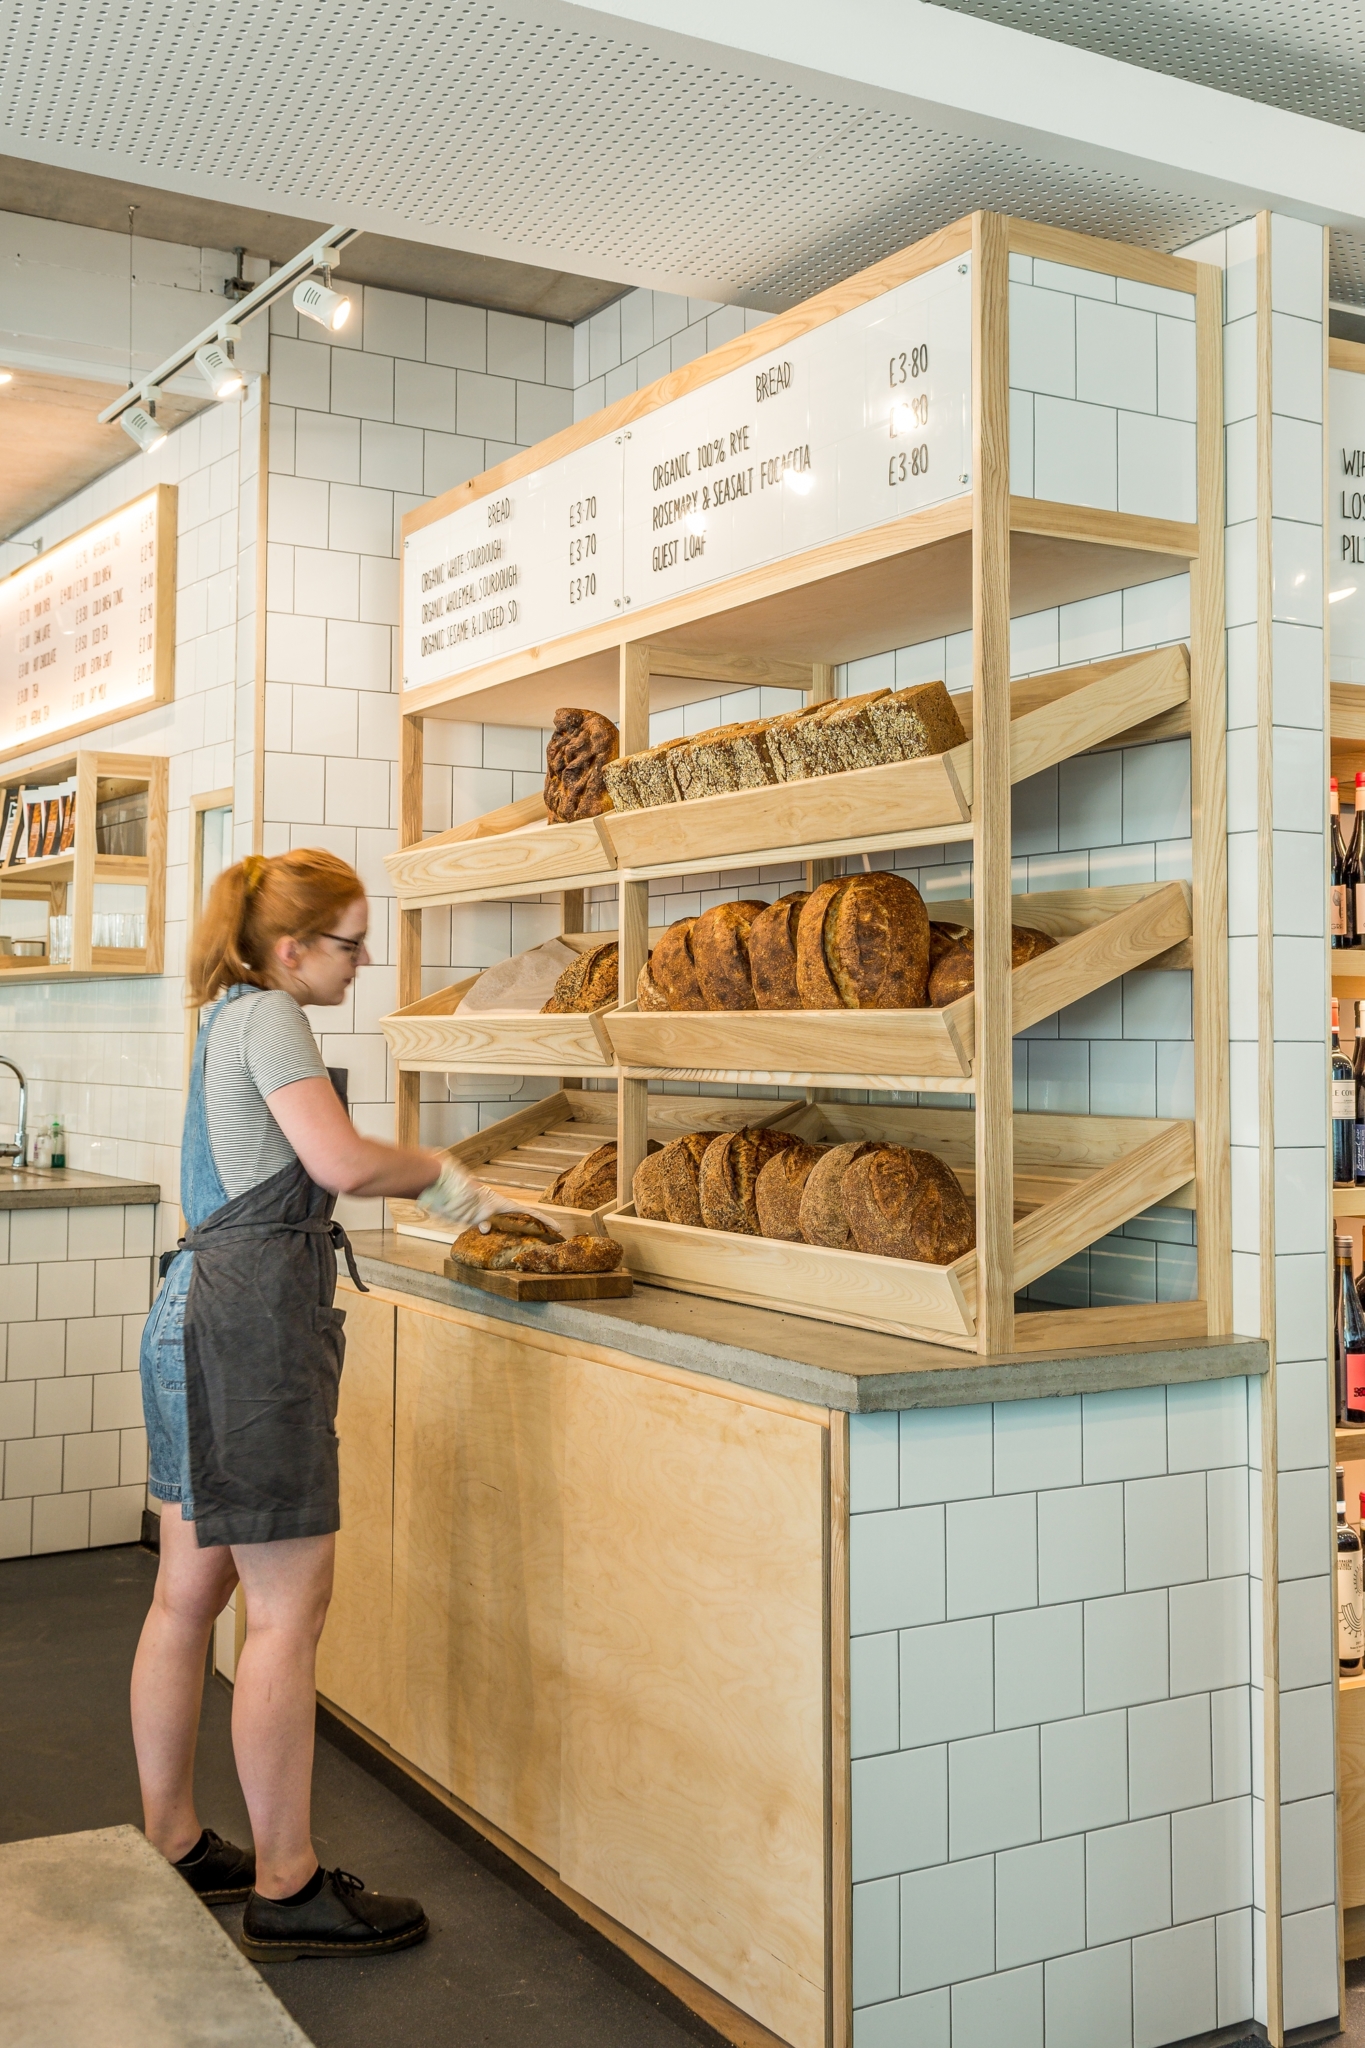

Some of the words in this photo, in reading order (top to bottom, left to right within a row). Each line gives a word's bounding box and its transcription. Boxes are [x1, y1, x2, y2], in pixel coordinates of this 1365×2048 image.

[756, 361, 791, 402] BREAD
[653, 451, 691, 491] ORGANIC
[697, 437, 726, 471] 100%
[730, 425, 750, 456] RYE
[488, 497, 510, 528] BREAD
[653, 490, 698, 531] ROSEMARY
[702, 486, 711, 510] &
[713, 467, 754, 507] SEASALT
[422, 563, 444, 593] ORGANIC
[446, 554, 464, 579] WHITE
[467, 538, 502, 571] SOURDOUGH
[653, 539, 679, 572] GUEST
[422, 596, 444, 624] ORGANIC
[445, 583, 476, 613] WHOLEMEAL
[479, 564, 518, 600] SOURDOUGH
[421, 629, 444, 658] ORGANIC
[446, 619, 468, 647] SESAME
[472, 615, 477, 638] &
[479, 606, 504, 635] LINSEED
[508, 599, 518, 624] SD
